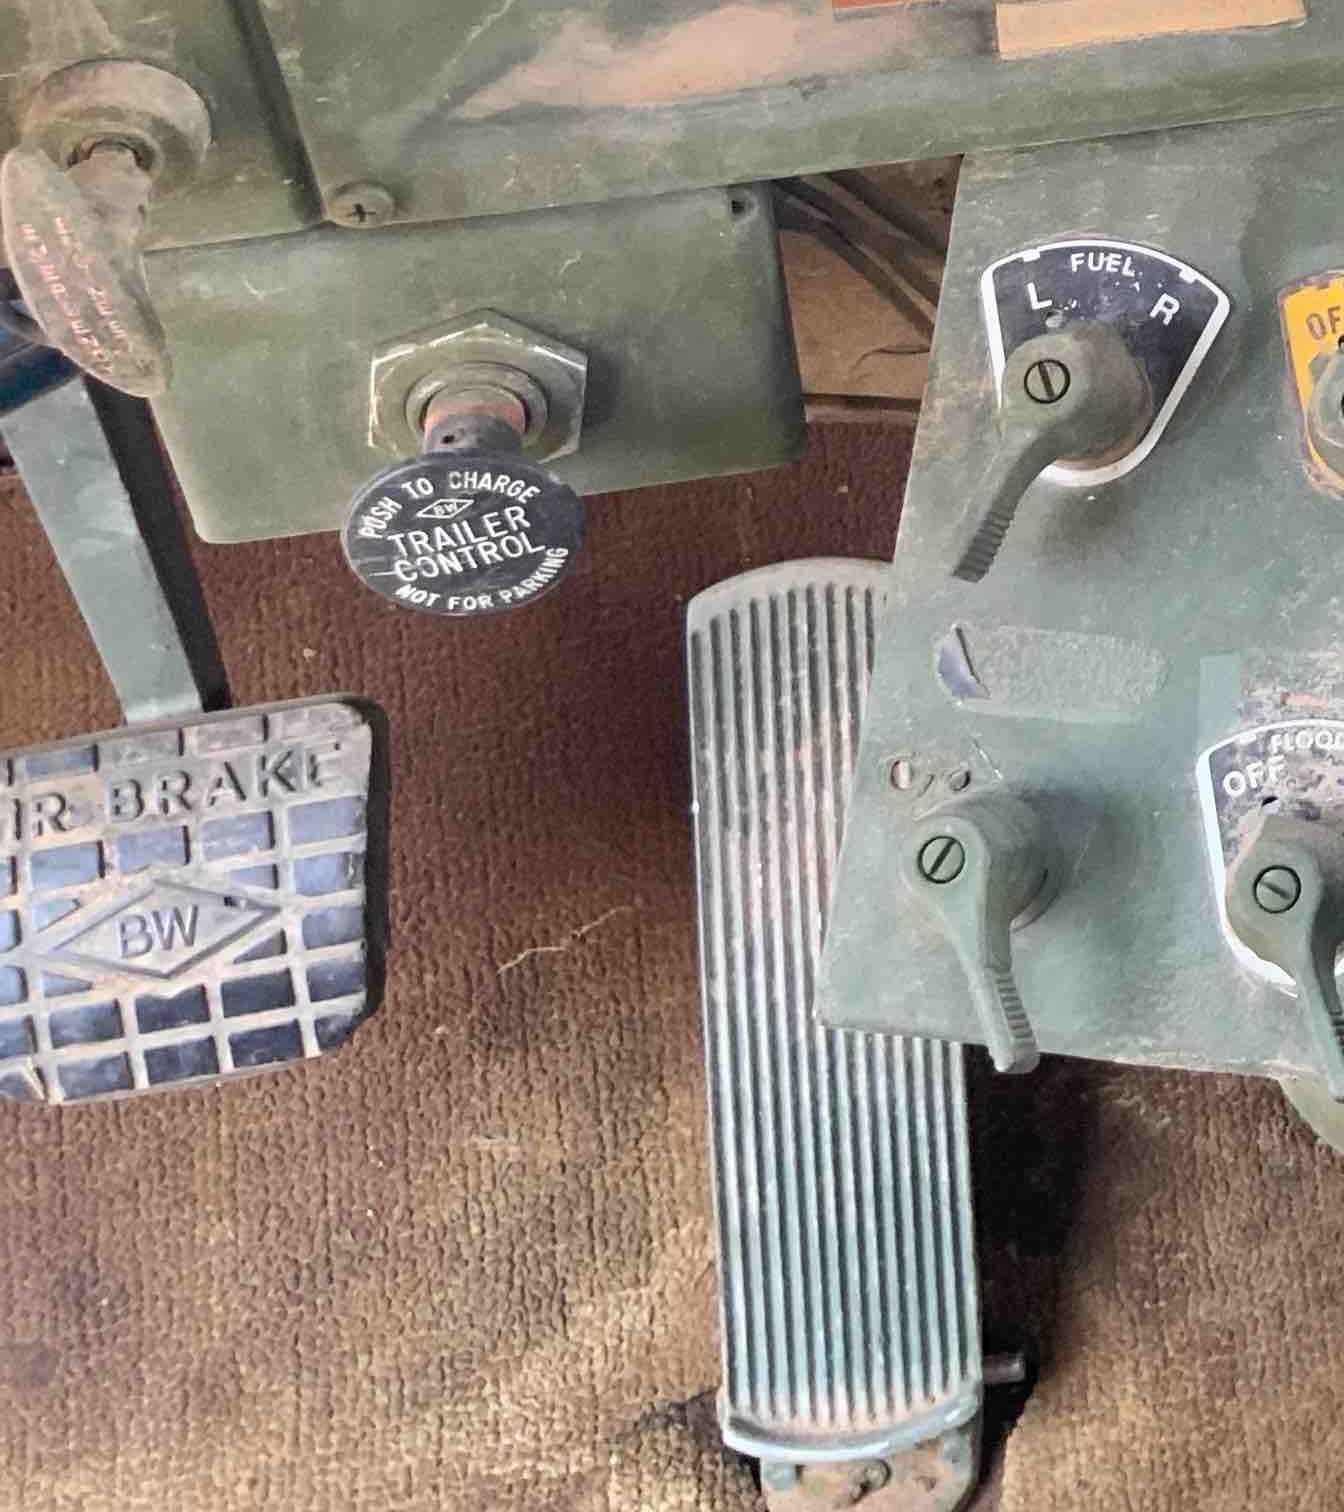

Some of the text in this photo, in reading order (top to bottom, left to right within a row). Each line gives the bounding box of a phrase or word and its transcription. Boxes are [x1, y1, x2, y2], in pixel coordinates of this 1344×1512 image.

[1070, 252, 1136, 277] FUEL
[1027, 282, 1052, 310] L
[1151, 293, 1181, 327] R
[358, 471, 541, 539] PUSH TO CHARGE
[387, 505, 531, 558] TRAILER
[394, 532, 546, 582] CONTROL
[395, 546, 569, 610] NOT FOR PARKING
[12, 746, 340, 841] IR BRAKE
[1223, 754, 1285, 798] OFF
[118, 904, 199, 959] BW
